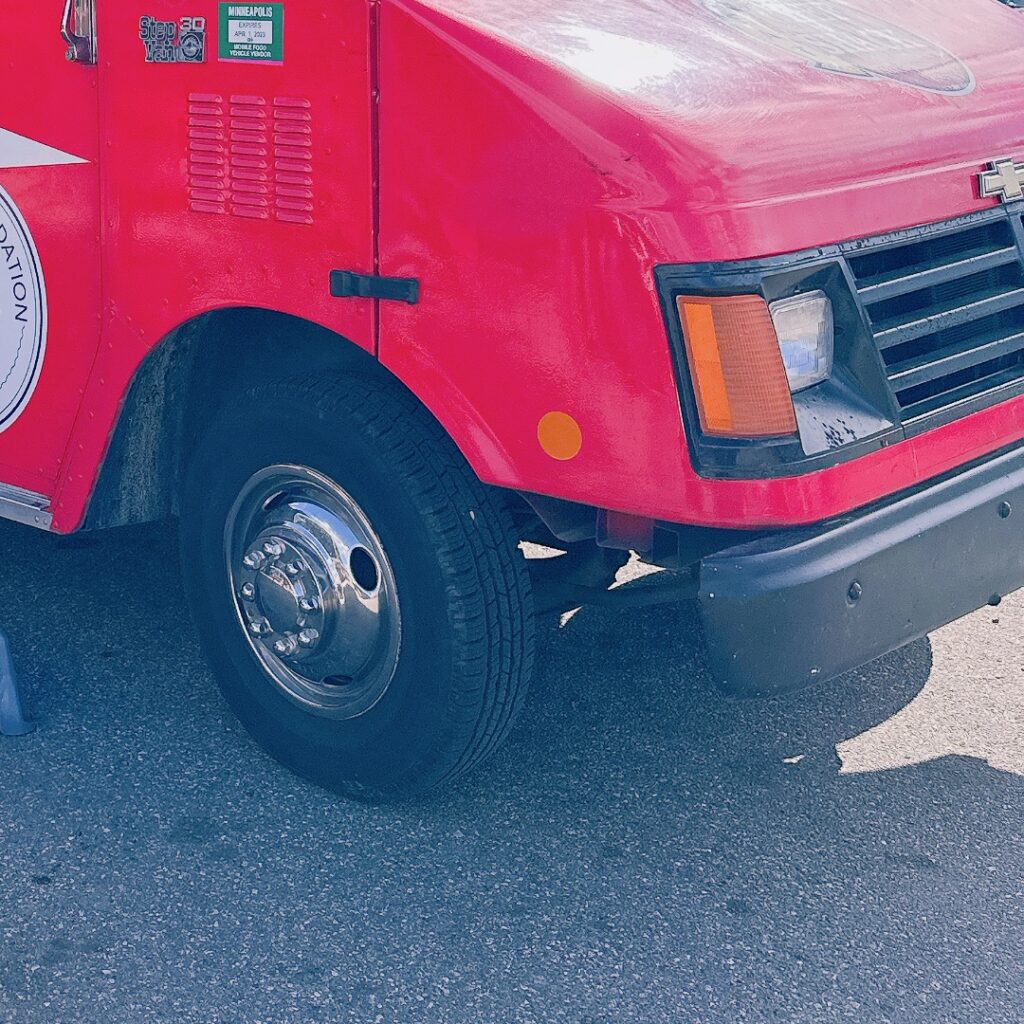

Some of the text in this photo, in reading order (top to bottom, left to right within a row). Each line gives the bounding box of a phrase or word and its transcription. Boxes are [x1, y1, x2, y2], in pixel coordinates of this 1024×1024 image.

[228, 6, 273, 18] MINNEAPOLIS
[139, 14, 206, 40] Step 30
[144, 39, 175, 63] Van
[229, 49, 272, 58] VEHICLE VENDOR
